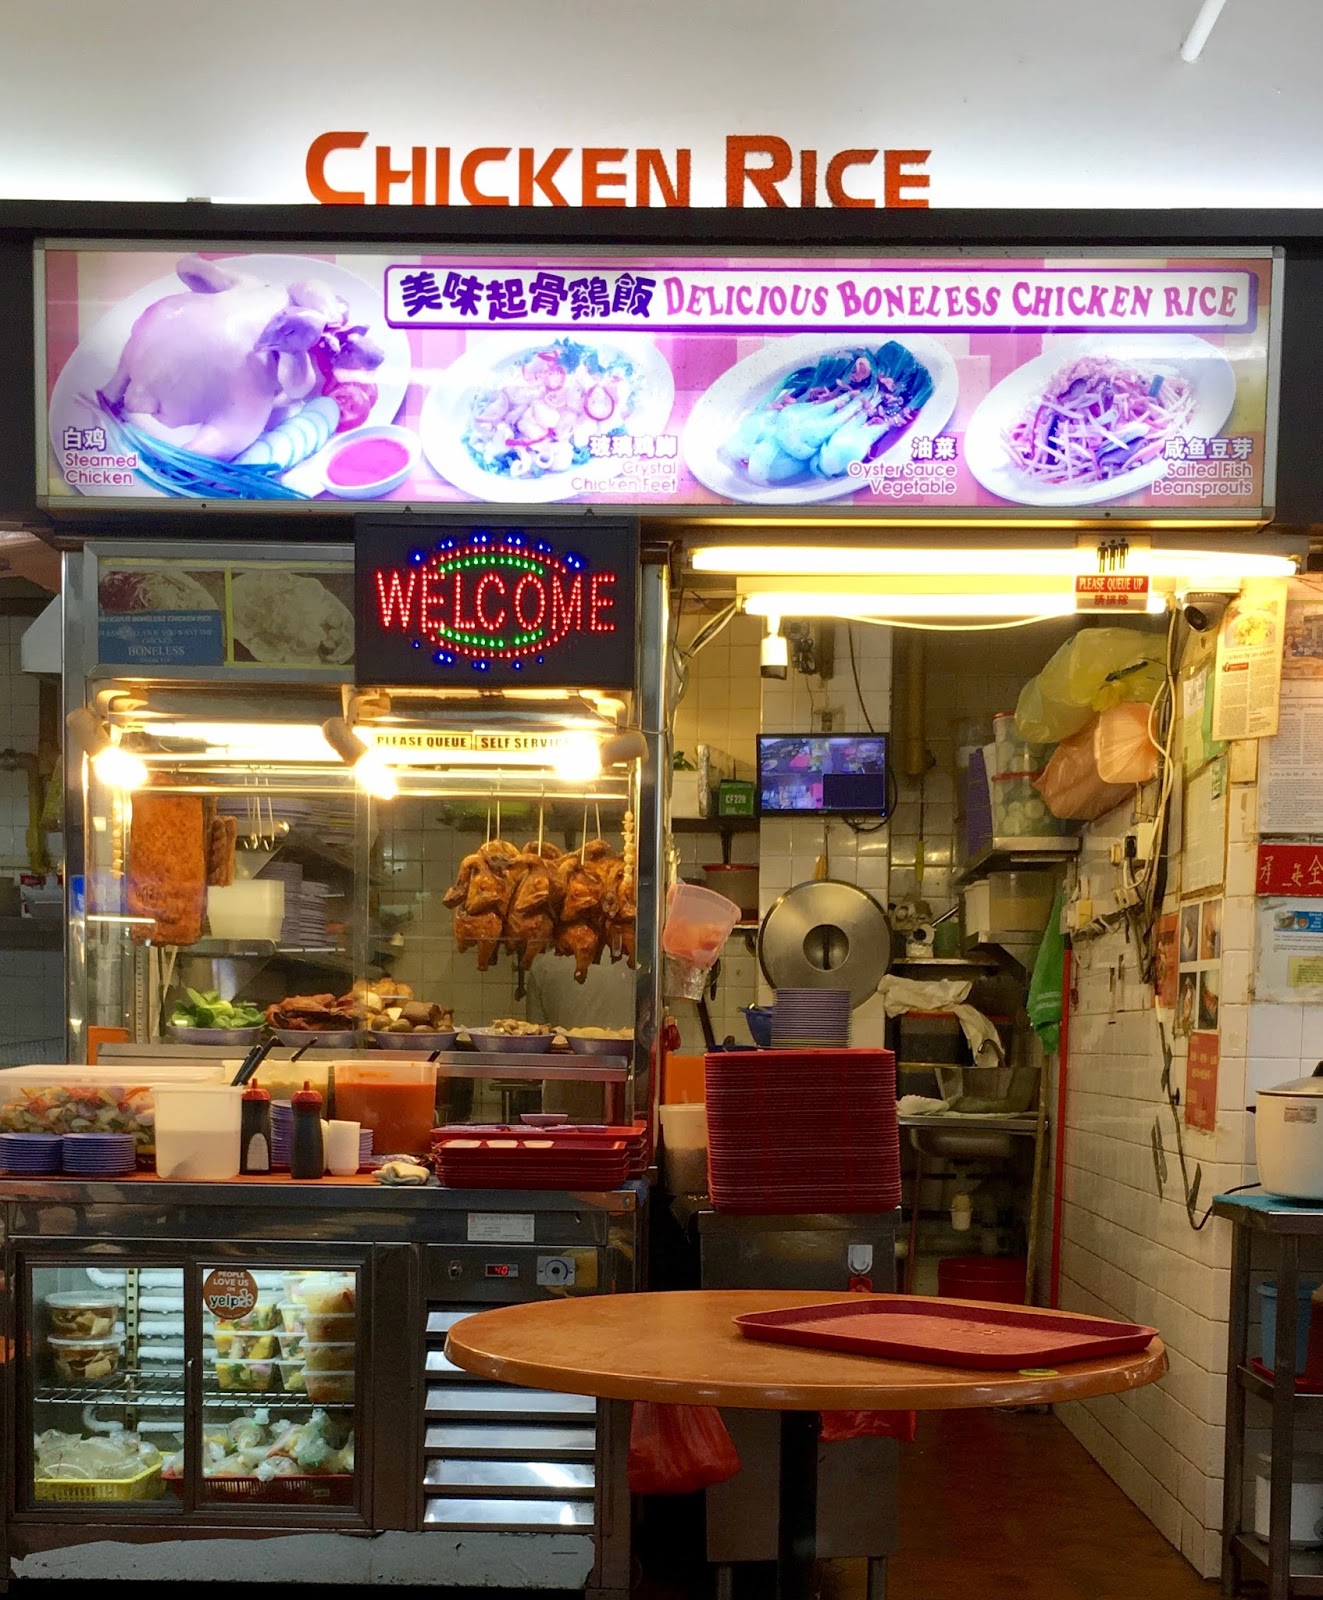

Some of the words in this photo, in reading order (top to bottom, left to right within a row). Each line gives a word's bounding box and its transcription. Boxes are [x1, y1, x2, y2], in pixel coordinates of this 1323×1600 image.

[306, 131, 691, 207] CHICKEN
[726, 135, 932, 208] RICE
[664, 276, 829, 316] DELICIOUS
[837, 280, 1000, 317] BONELESS
[1012, 281, 1154, 317] CHICKEN
[1164, 285, 1238, 318] RICE
[63, 426, 106, 452] 白鸡
[911, 436, 958, 461] 油菜
[1162, 436, 1254, 461] 咸鱼豆芽
[65, 452, 137, 467] Steamed
[65, 470, 133, 484] Chicken
[622, 461, 676, 477] Crystal
[849, 462, 901, 478] Oyster
[905, 462, 956, 476] Sauce
[1167, 463, 1217, 477] Salted
[1222, 463, 1252, 477] Fish
[571, 477, 638, 491] Chicken
[643, 478, 677, 491] Feet
[870, 479, 956, 497] Vegetable
[1153, 480, 1252, 497] Beansprouts
[1079, 577, 1105, 591] PLEASE
[1107, 577, 1131, 592] QUEUE
[1133, 577, 1144, 591] UP
[376, 571, 615, 633] WELCOME
[128, 646, 186, 656] BONELESS
[377, 736, 423, 747] PLEASE
[426, 736, 467, 748] QUEUE
[481, 737, 510, 749] SELF
[213, 1278, 236, 1286] LOVE
[238, 1279, 250, 1287] US
[218, 1270, 246, 1279] PEOPLE
[209, 1293, 240, 1310] yelp
